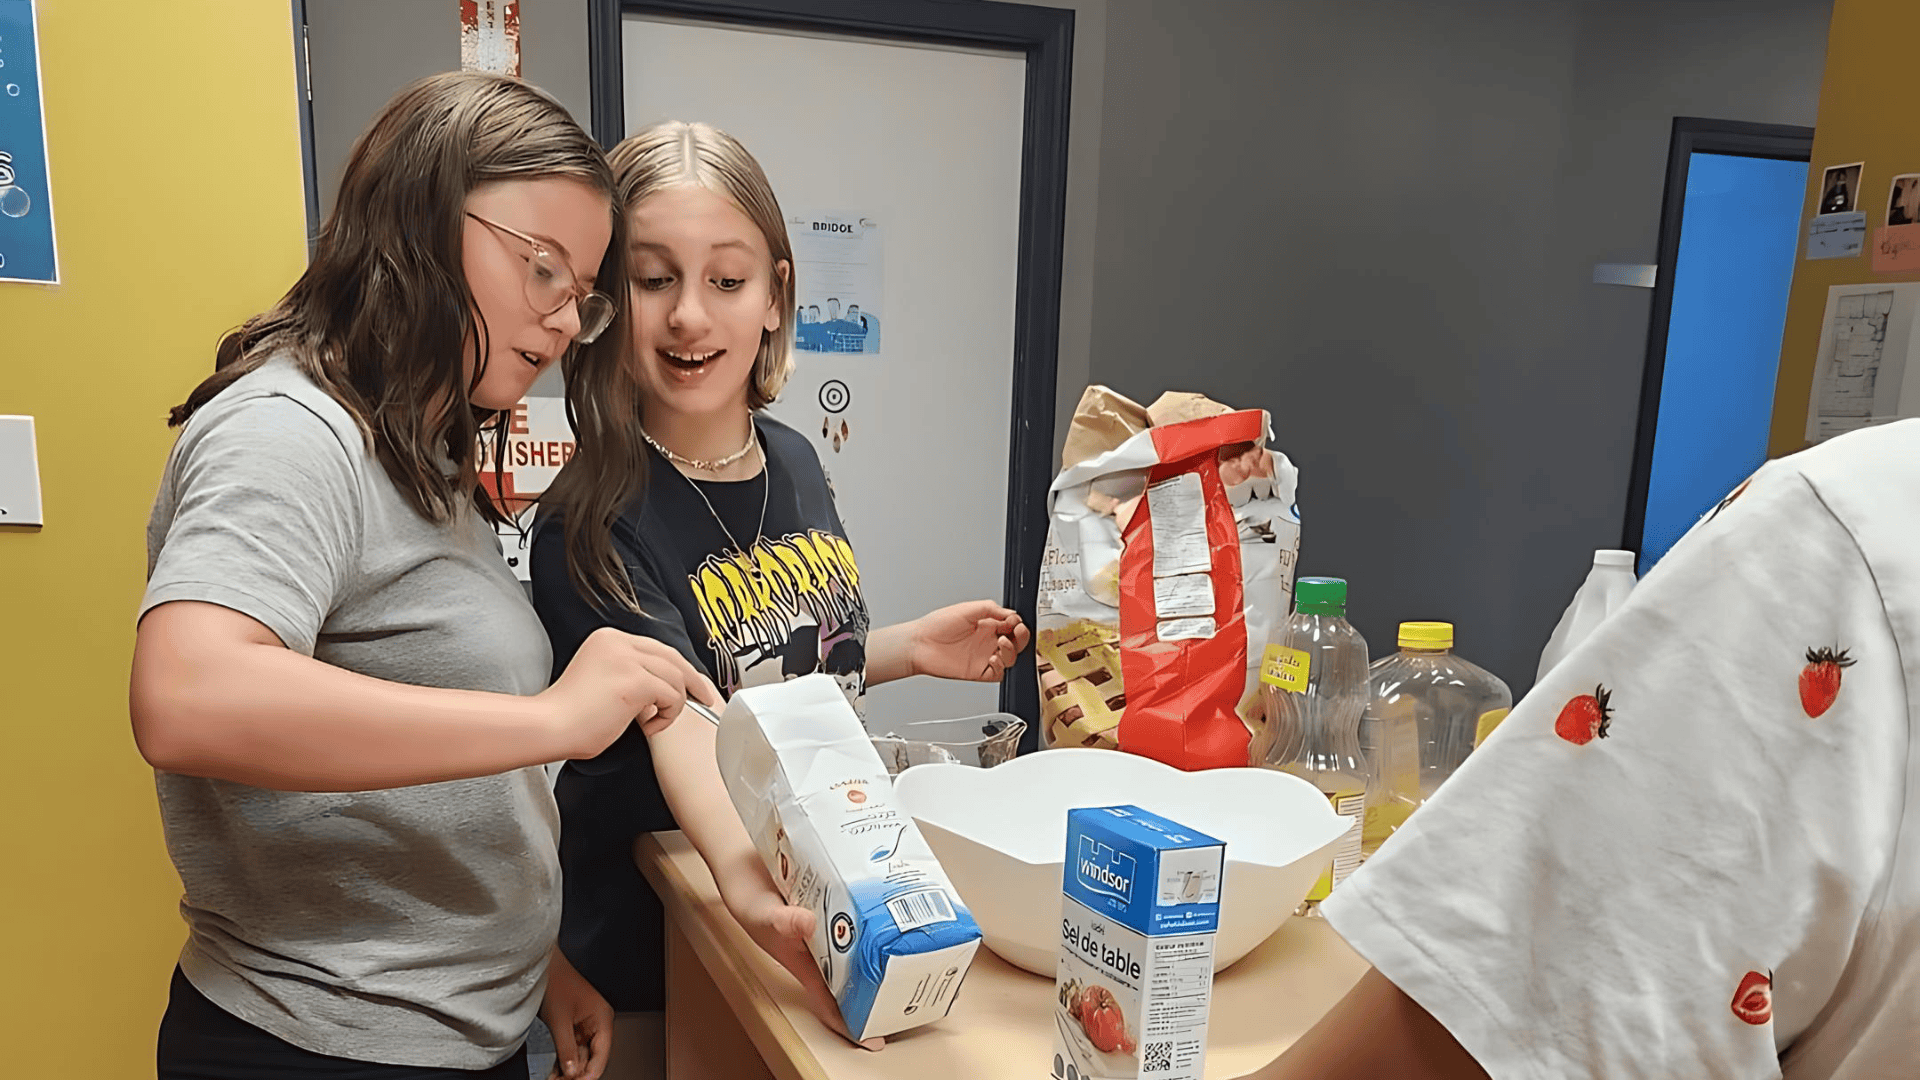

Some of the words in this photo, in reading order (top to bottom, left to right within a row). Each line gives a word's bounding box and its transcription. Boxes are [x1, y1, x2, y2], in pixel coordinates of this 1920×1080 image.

[1062, 917, 1080, 948] Sel
[1081, 931, 1098, 958] de
[1101, 943, 1141, 980] table
